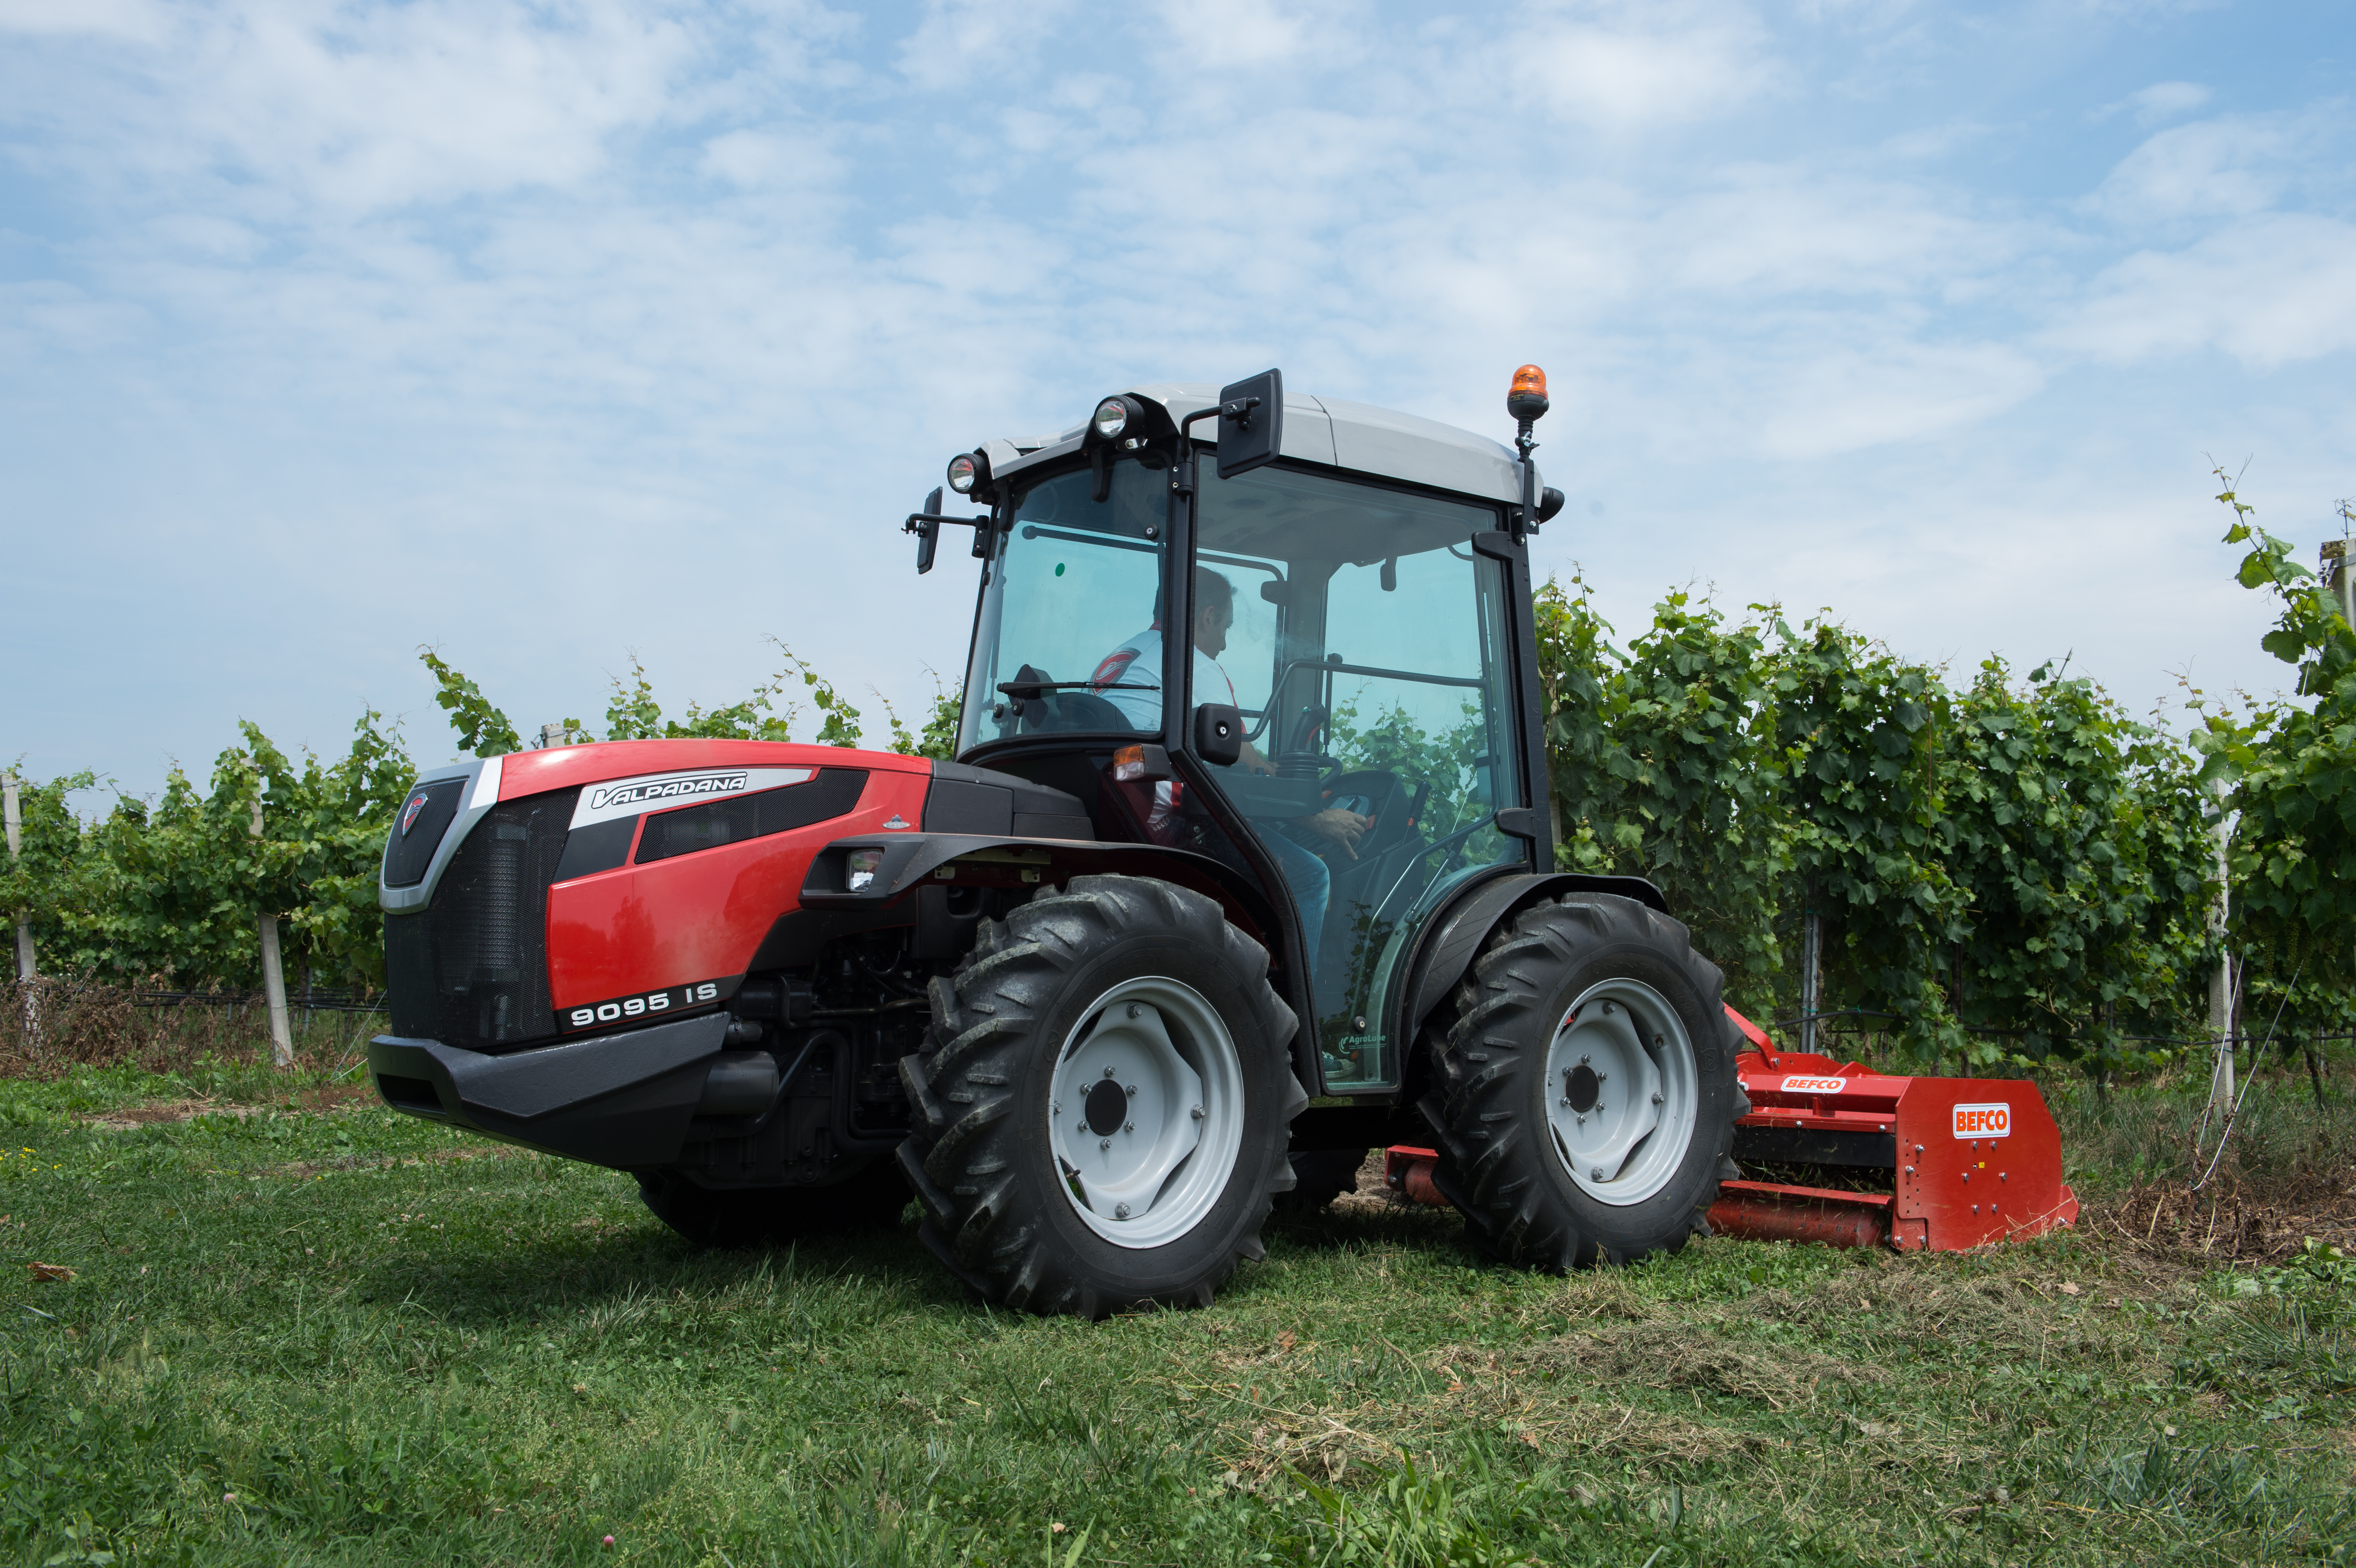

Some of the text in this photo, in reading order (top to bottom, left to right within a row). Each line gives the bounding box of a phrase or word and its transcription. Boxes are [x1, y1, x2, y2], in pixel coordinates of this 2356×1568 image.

[591, 772, 747, 809] VALPADANA
[571, 983, 717, 1026] 9095 IS
[1671, 987, 1696, 1019] VIGNE
[1349, 1034, 1386, 1045] AgroLube
[1785, 1078, 1841, 1090] BEFCO
[1956, 1110, 2007, 1132] BEFCO
